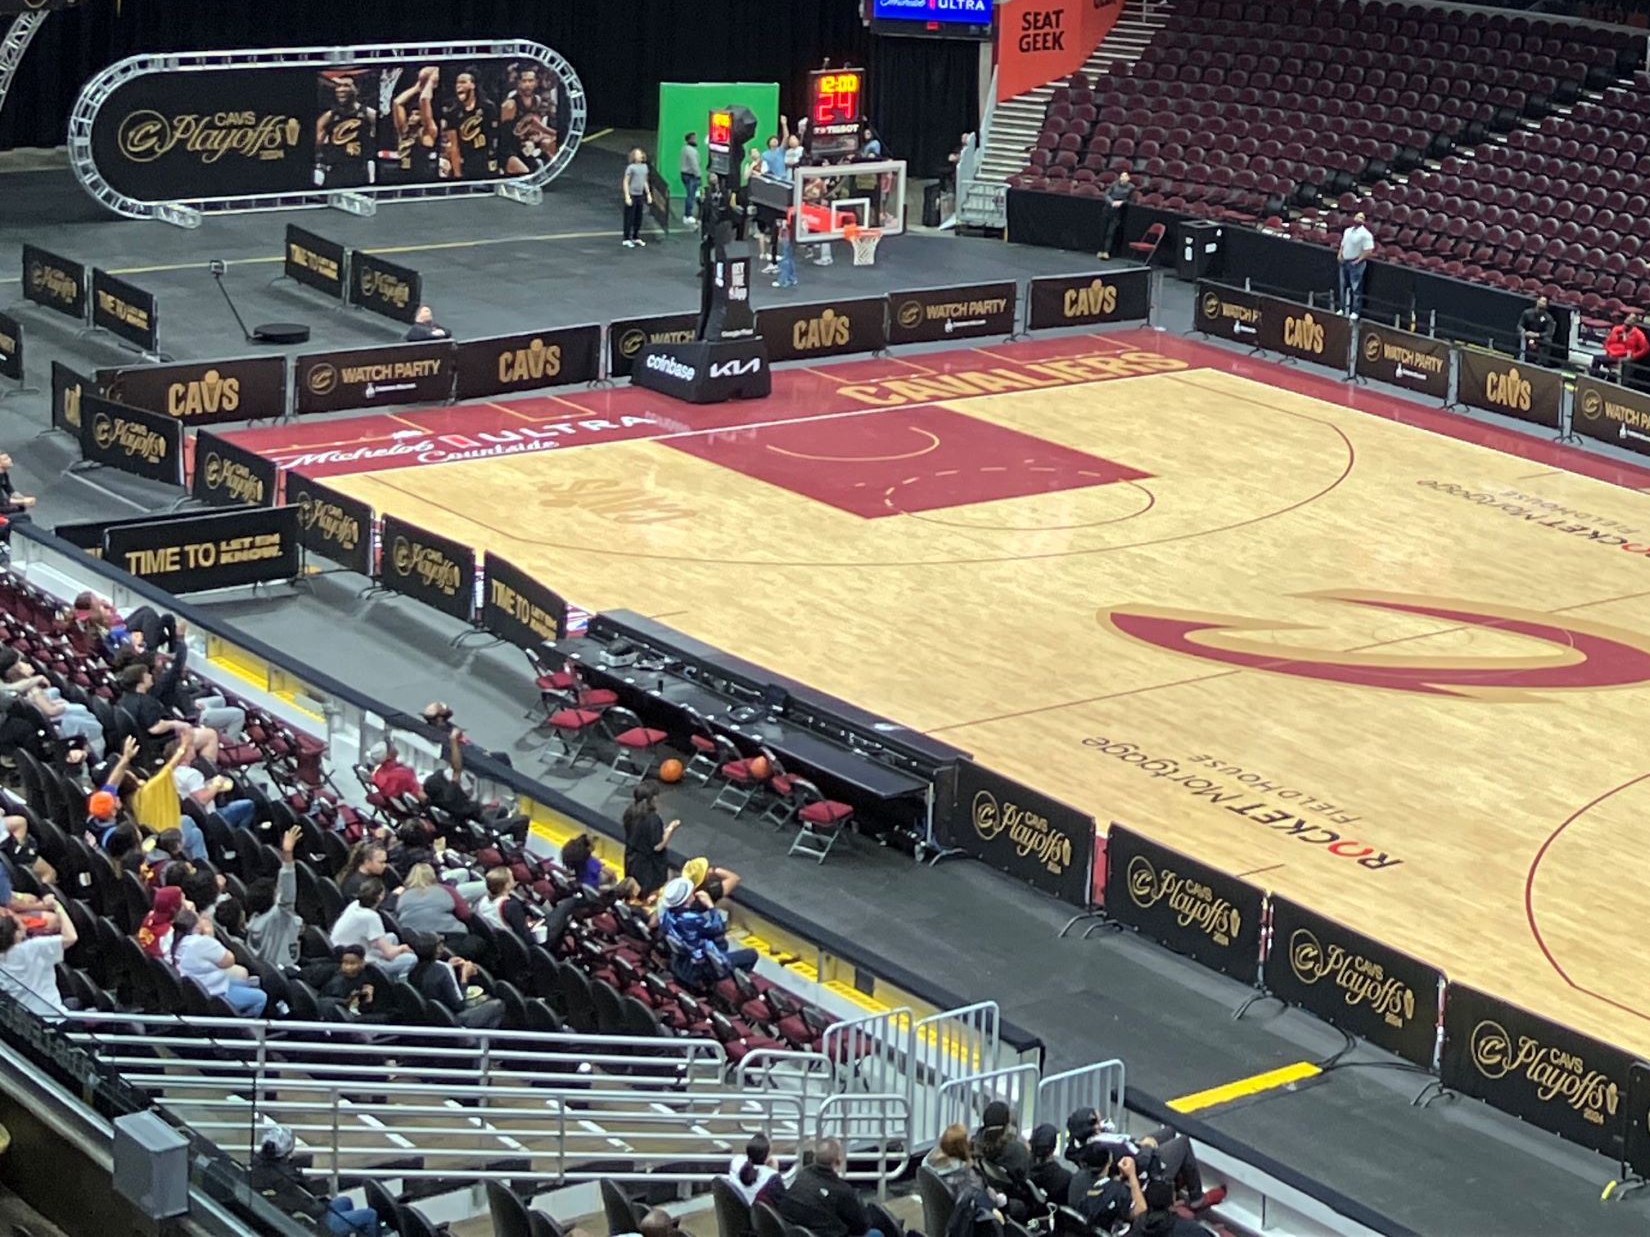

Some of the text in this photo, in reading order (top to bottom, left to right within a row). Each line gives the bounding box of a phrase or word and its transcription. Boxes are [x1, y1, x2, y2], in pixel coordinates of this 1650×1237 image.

[1022, 9, 1064, 32] SEAT
[1018, 31, 1064, 53] GEEK
[820, 73, 857, 93] 12:00
[214, 112, 255, 127] CAVS
[817, 92, 856, 122] 24
[156, 114, 289, 164] Playoffs
[926, 297, 1007, 322] WATCH PARTY
[1063, 279, 1117, 318] CAVS
[793, 308, 851, 350] CAVS
[1283, 313, 1325, 354] CAVS
[340, 359, 441, 383] WATCH PARTY
[499, 338, 562, 384] CAVS
[646, 353, 696, 382] coinbase
[1382, 344, 1415, 365] WATCH
[1413, 352, 1445, 375] PARTY
[168, 369, 240, 416] CAVS
[836, 350, 1190, 407] CAVALIERS
[1486, 367, 1532, 412] CAVS
[1604, 401, 1641, 425] WATCH
[276, 412, 659, 471] Michelob ULTRA
[417, 438, 560, 464] Courtside
[125, 547, 181, 576] TIME
[184, 542, 216, 570] TO
[1081, 735, 1404, 871] ROCKET Mortgage
[1186, 753, 1362, 825] FIELDHOUSE
[994, 801, 1062, 866] Playoffs
[1024, 811, 1050, 831] CAVS
[1151, 867, 1231, 937] Playoffs
[1184, 878, 1213, 900] CAVS
[1314, 944, 1404, 1016] Playoffs
[1354, 956, 1384, 981] CAVS
[1504, 1035, 1608, 1115] Playoffs
[1549, 1047, 1584, 1072] CAVS
